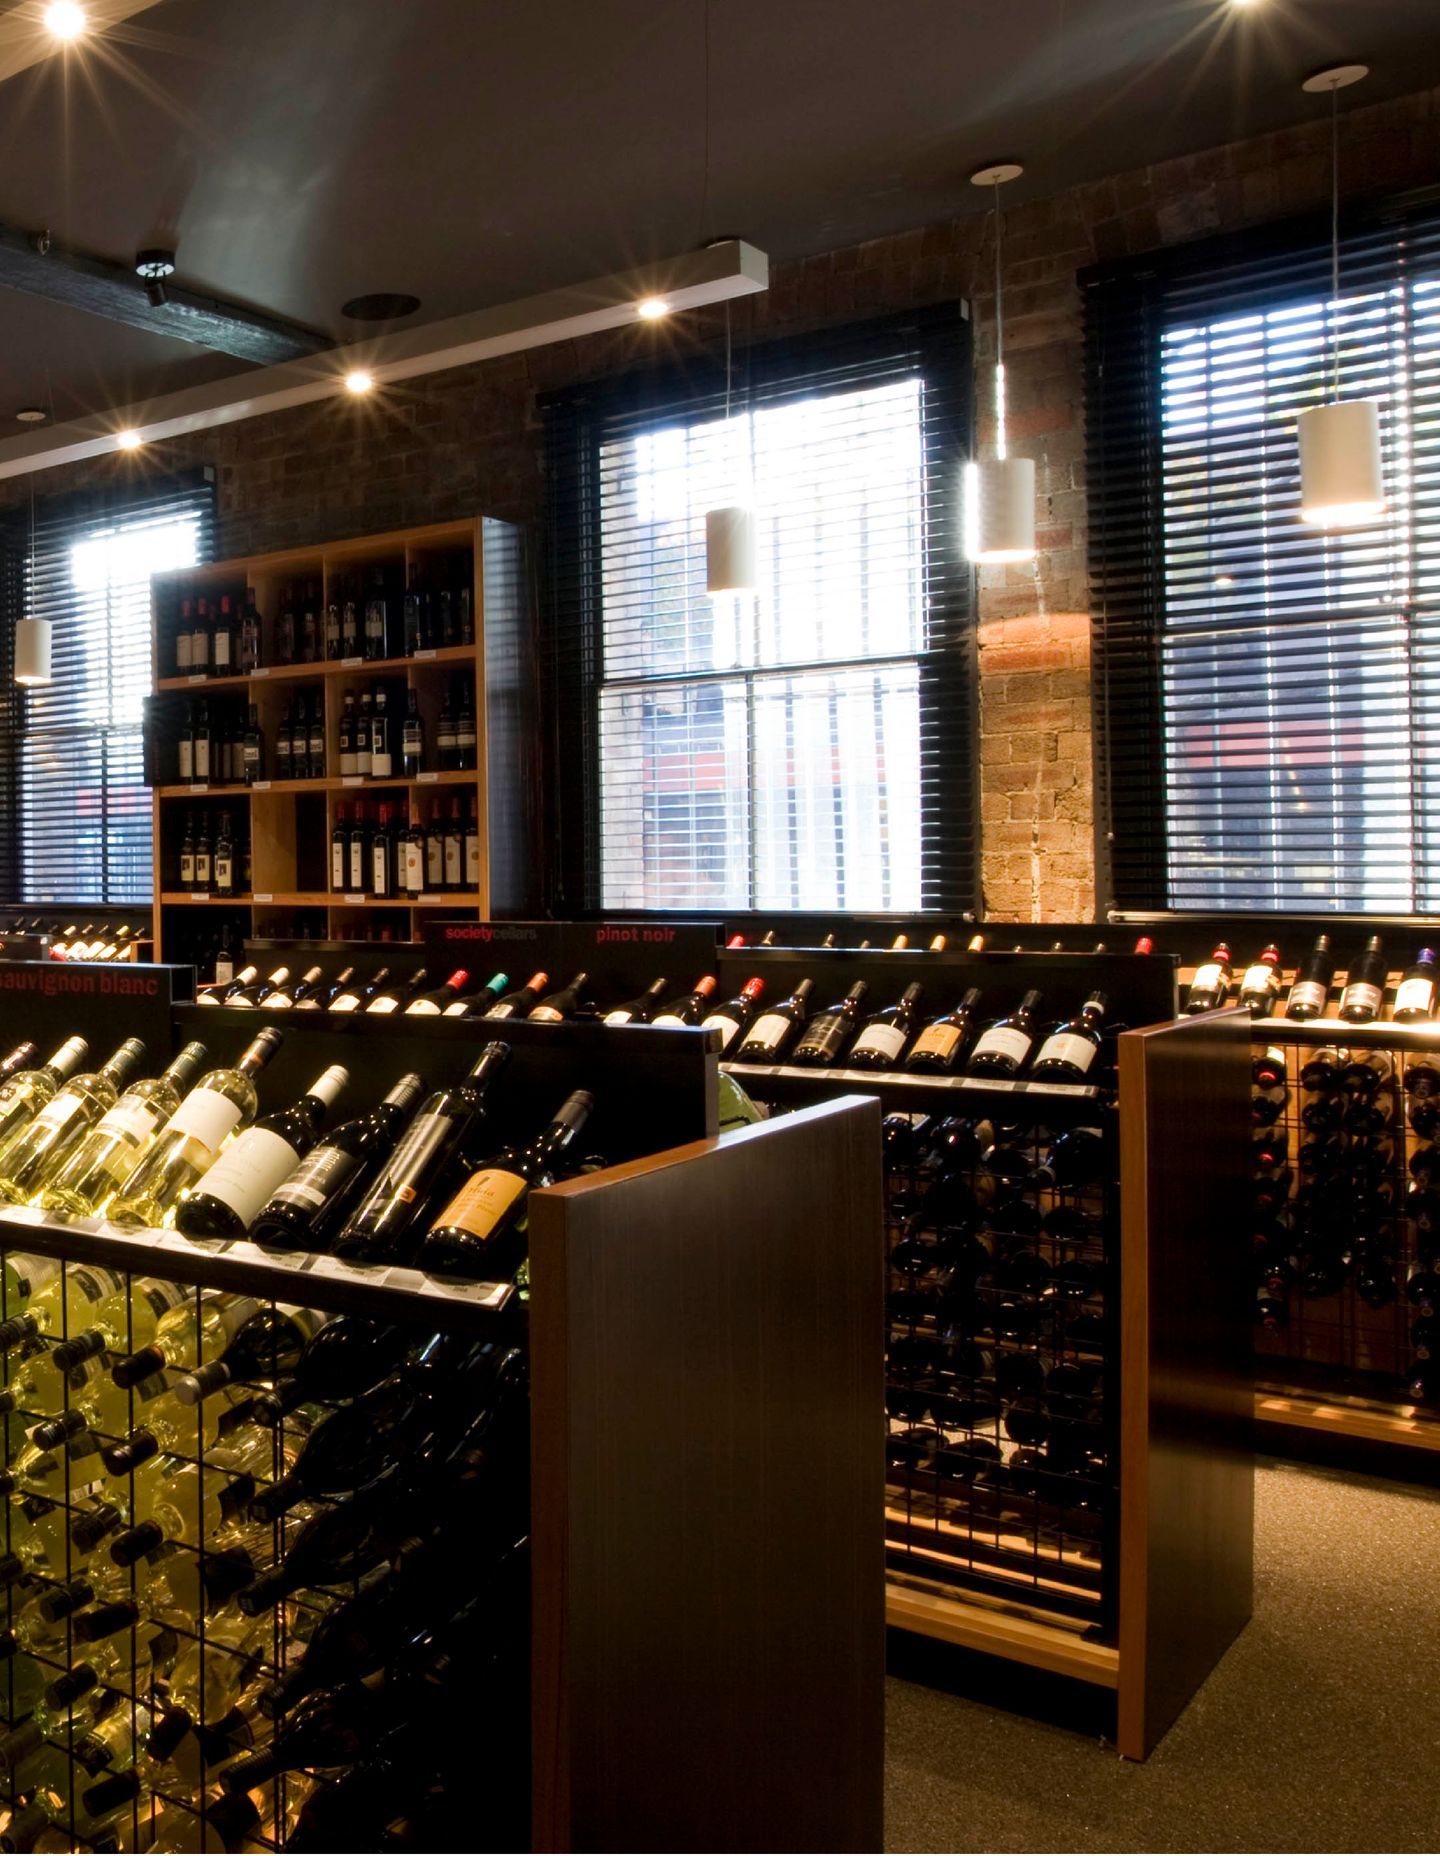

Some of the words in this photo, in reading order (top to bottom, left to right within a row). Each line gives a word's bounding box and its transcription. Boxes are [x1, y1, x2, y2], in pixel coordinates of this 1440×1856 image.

[595, 926, 639, 945] pinot
[642, 927, 676, 942] noir
[99, 970, 160, 996] blanc
